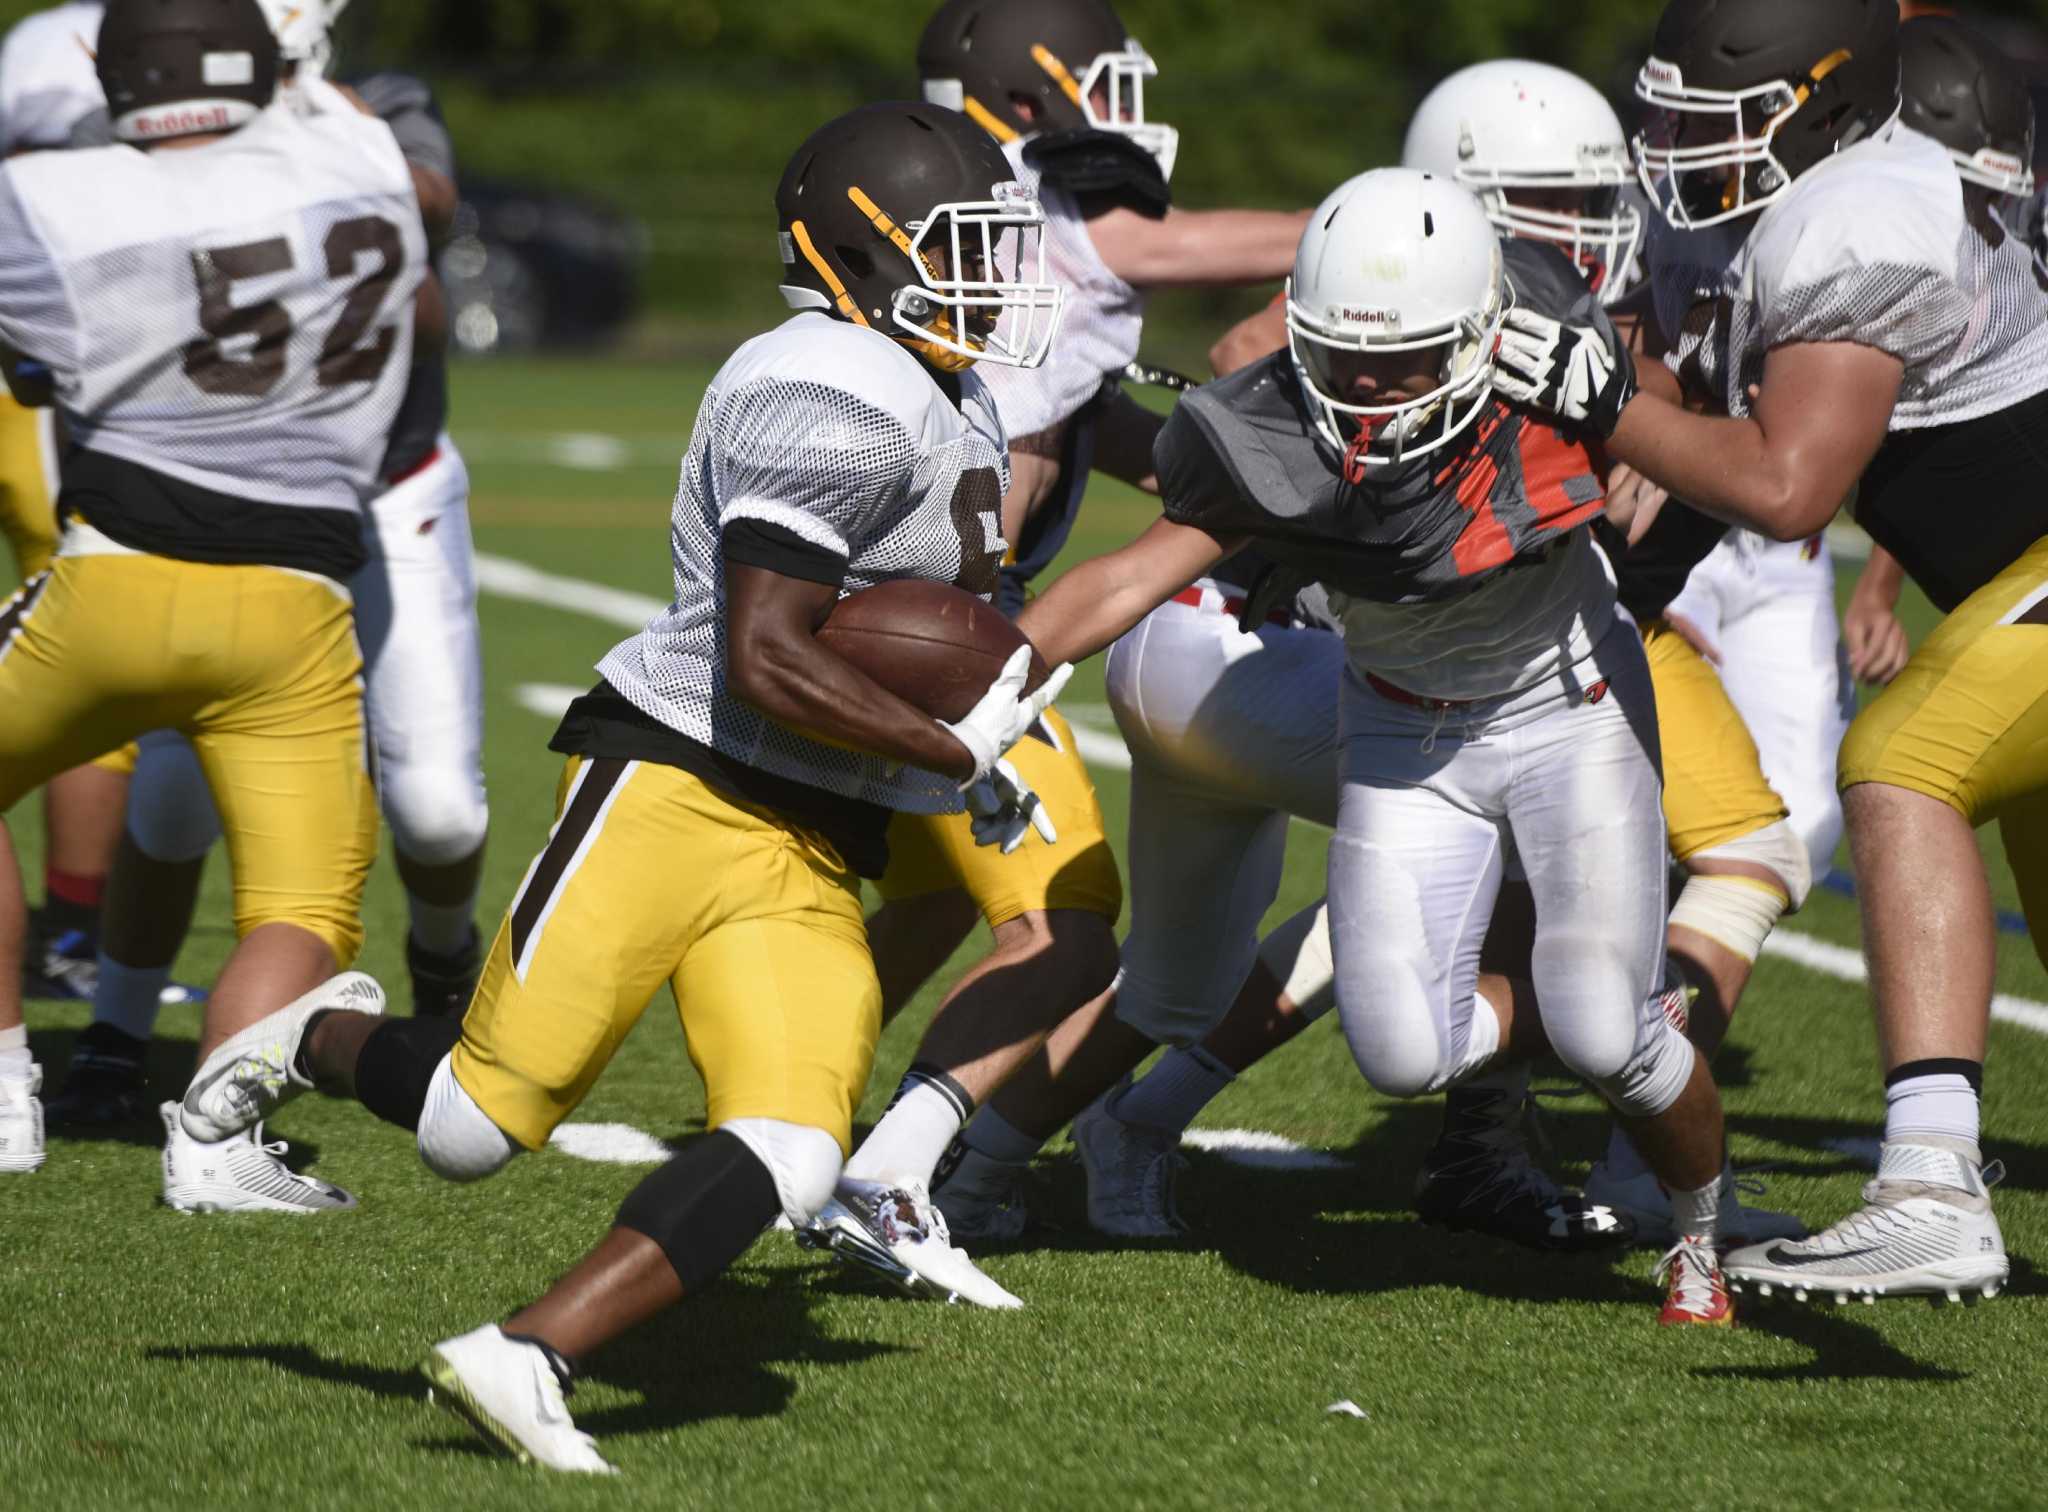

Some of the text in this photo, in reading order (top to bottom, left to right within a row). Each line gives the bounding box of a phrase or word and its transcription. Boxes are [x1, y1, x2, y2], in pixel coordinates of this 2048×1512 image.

[134, 106, 228, 134] Riddell
[182, 215, 402, 396] 52
[1343, 307, 1385, 323] Riddell
